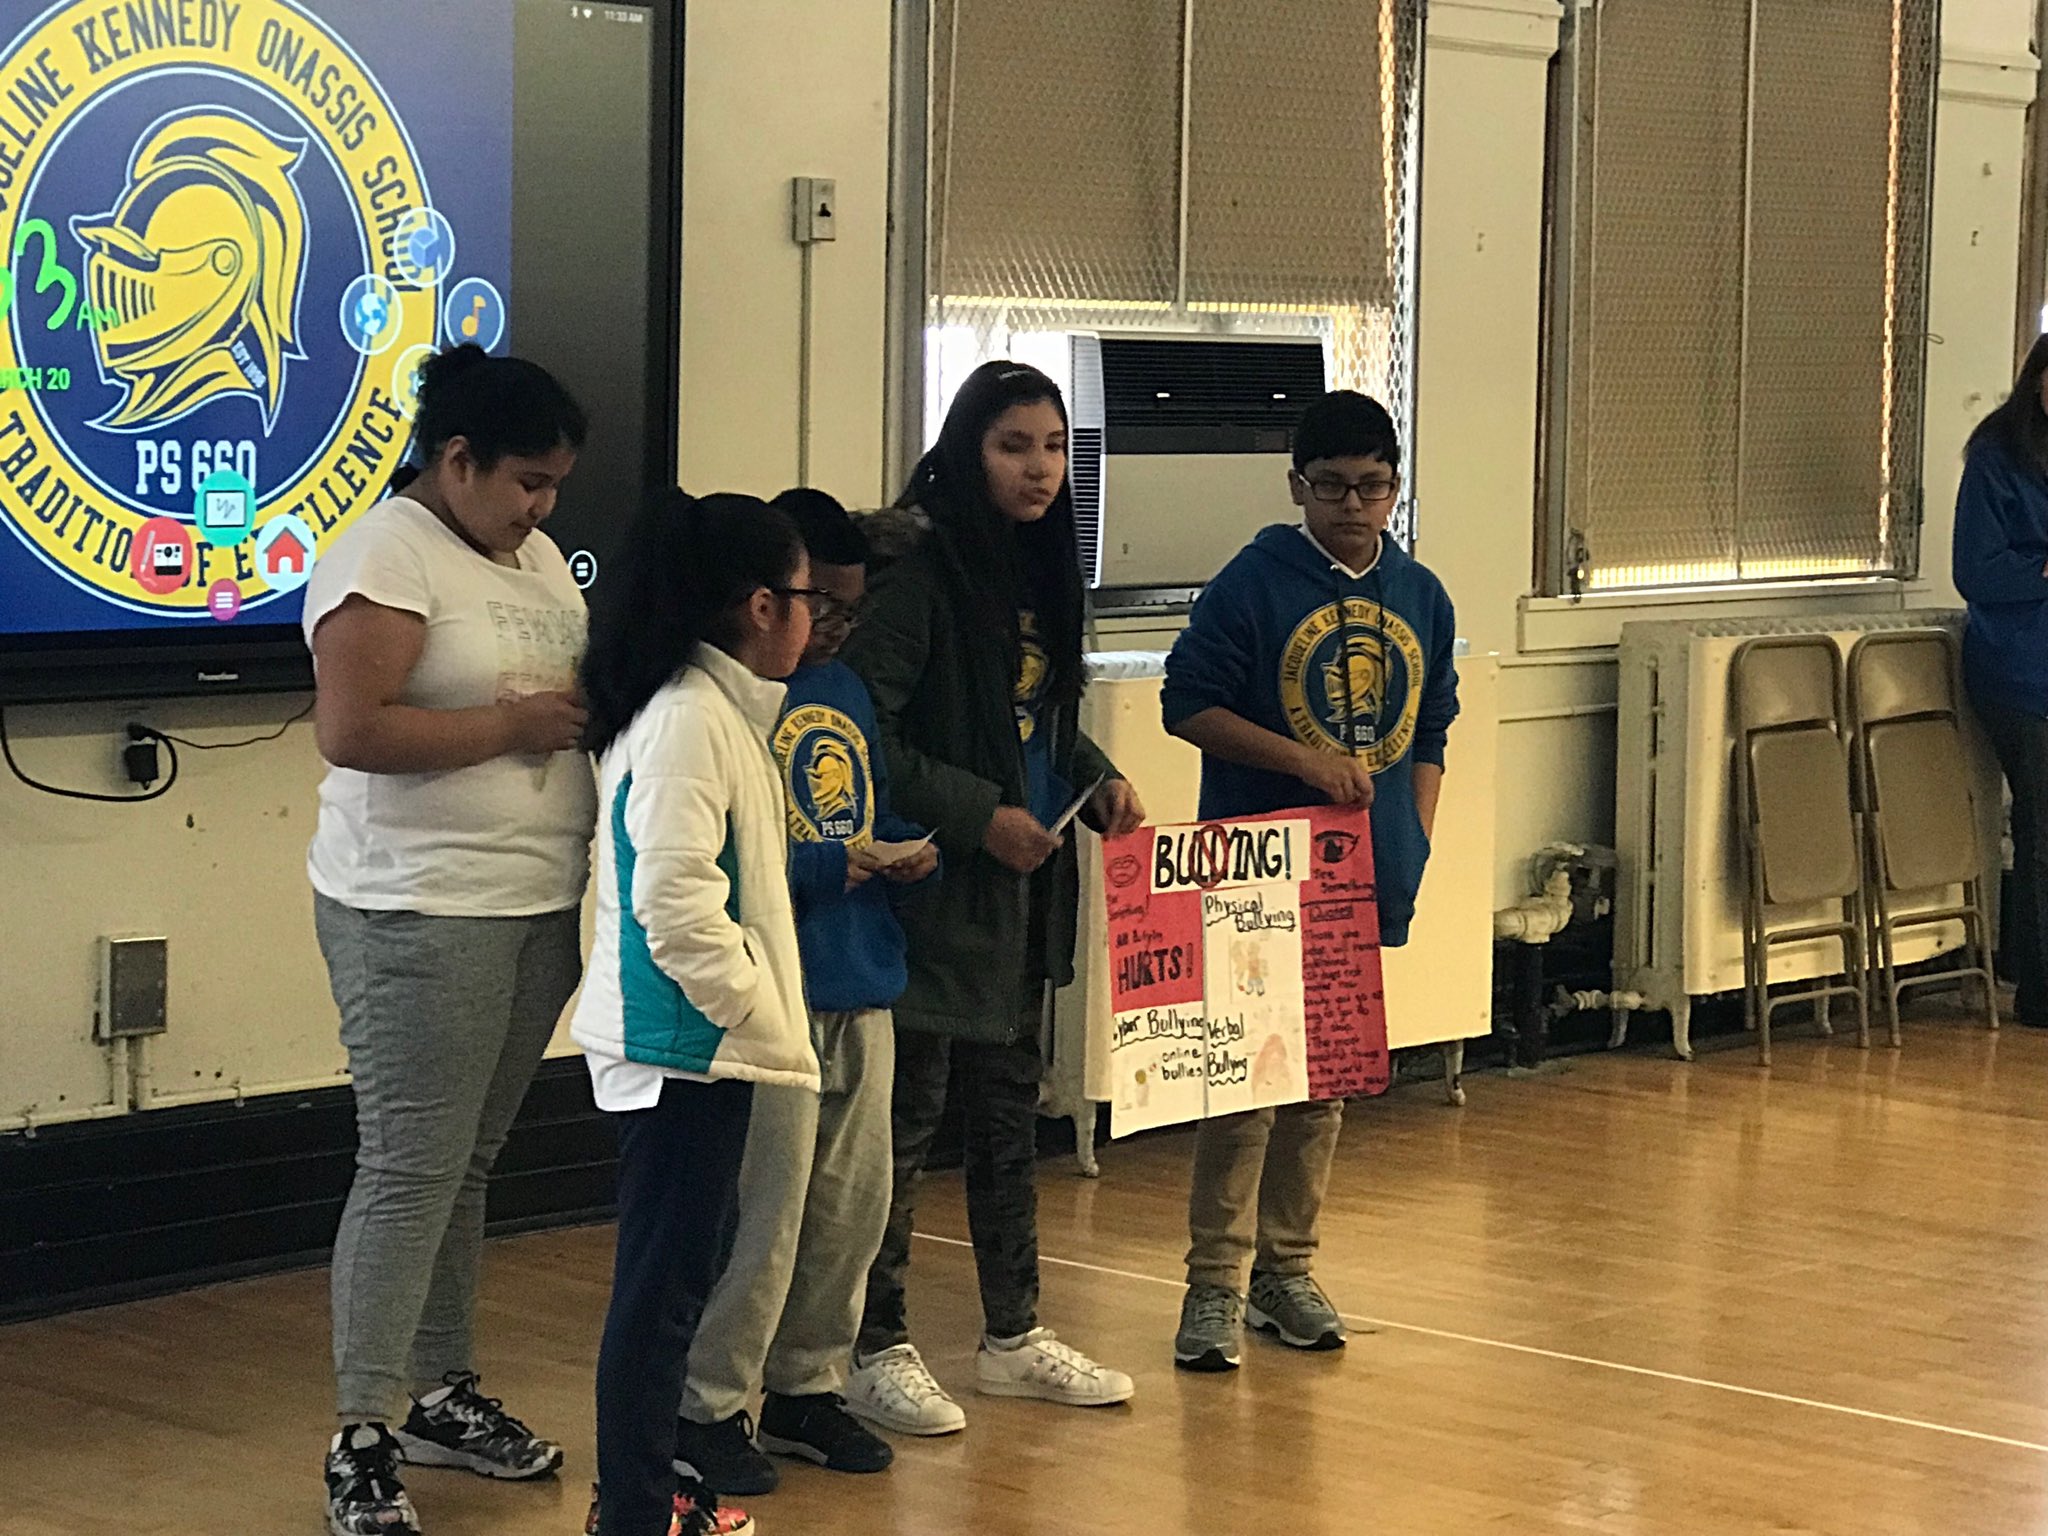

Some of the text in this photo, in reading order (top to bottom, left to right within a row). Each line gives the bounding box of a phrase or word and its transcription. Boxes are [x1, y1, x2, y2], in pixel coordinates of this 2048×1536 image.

[0, 48, 74, 212] UELINE
[72, 0, 241, 75] KENNEDY
[257, 18, 376, 151] ONASSIS
[77, 300, 121, 332] AM
[46, 367, 70, 390] 20
[136, 439, 182, 495] PS
[0, 411, 135, 576] TRADITIO
[234, 387, 402, 581] ELLENCE
[1284, 620, 1323, 684] JACQUELINE
[1407, 648, 1421, 688] SCHOOL
[1354, 725, 1376, 742] 660
[1155, 827, 1292, 888] BULLYING!
[1205, 892, 1264, 915] Physical
[1117, 943, 1194, 995] HURTS!
[1207, 1012, 1244, 1040] Verbal
[1161, 1047, 1202, 1062] online
[1161, 1062, 1204, 1080] bullies
